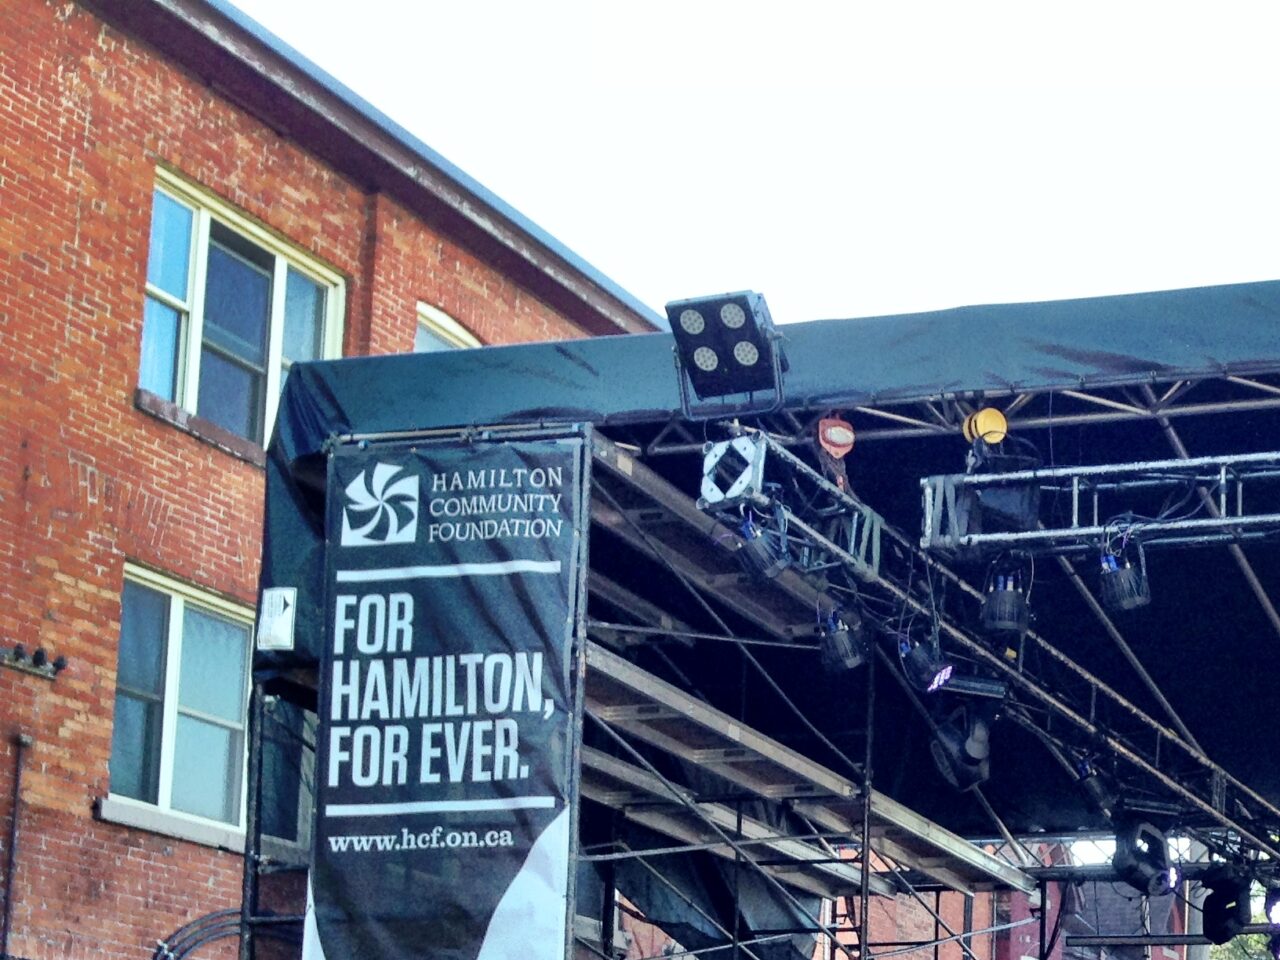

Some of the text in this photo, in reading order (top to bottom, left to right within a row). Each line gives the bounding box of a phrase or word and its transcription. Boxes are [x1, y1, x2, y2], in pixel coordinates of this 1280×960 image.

[432, 467, 562, 492] HAMILTON
[430, 494, 562, 517] COMMUNITY
[429, 518, 562, 542] FOUNDATION
[333, 592, 414, 655] FOR
[331, 652, 554, 720] HAMILTON,
[328, 718, 529, 787] FOR EVER.
[328, 827, 514, 852] www.hcf.on.ca
